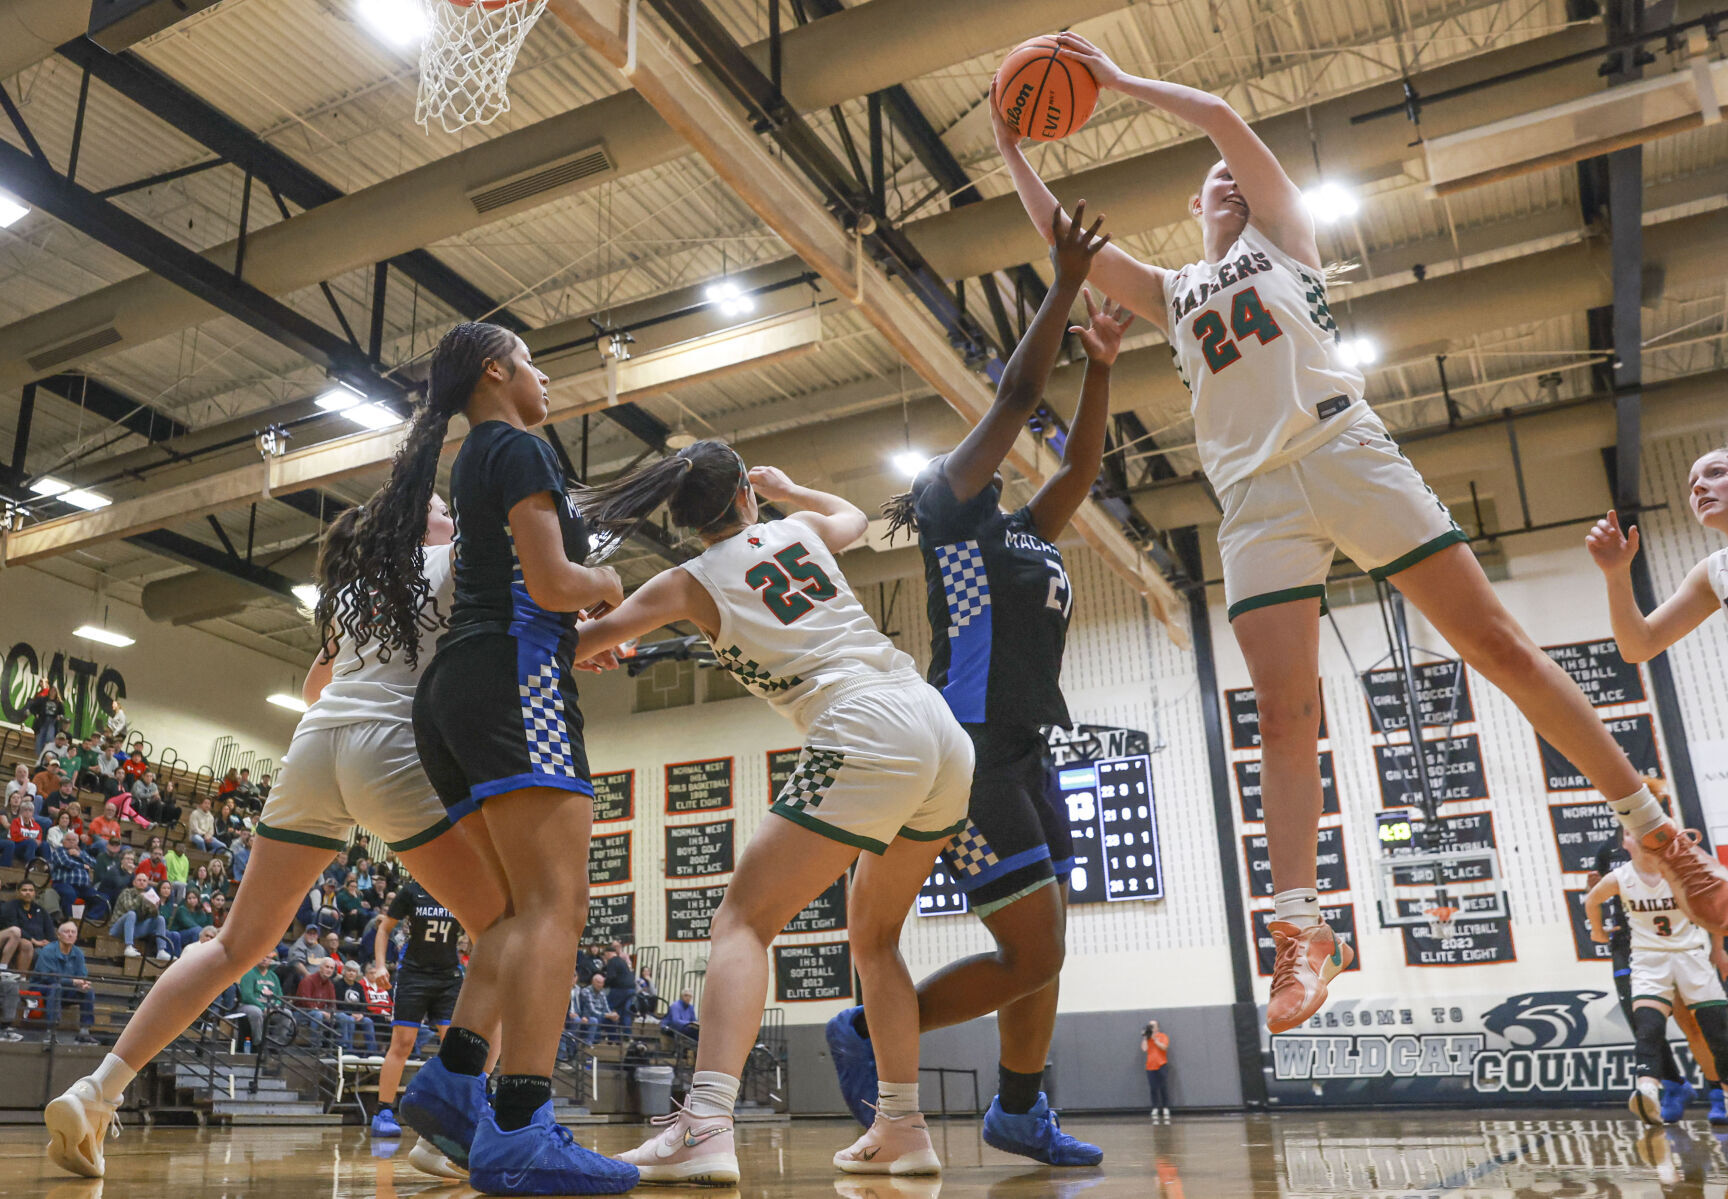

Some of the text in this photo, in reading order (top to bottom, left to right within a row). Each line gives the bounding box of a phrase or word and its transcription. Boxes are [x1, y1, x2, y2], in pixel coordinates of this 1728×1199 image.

[1192, 285, 1283, 375] 24
[745, 541, 838, 626] 25
[1447, 817, 1480, 830] WEST
[1593, 817, 1620, 829] IHS
[671, 823, 727, 837] NORMAL WEST
[689, 836, 710, 845] IHSA
[677, 843, 722, 856] BOYS GOLF
[697, 862, 722, 874] PLACE
[672, 891, 702, 900] NORMAL
[687, 900, 712, 909] IHSA
[812, 918, 836, 928] EIGHT
[1653, 915, 1672, 937] 3
[424, 920, 452, 943] 24
[1441, 938, 1473, 950] 2023
[781, 945, 843, 957] NORMAL WEST
[1421, 948, 1498, 963] ELITE EIGHT
[800, 957, 824, 966] IHSA
[790, 967, 835, 978] SOFTBALL
[787, 987, 840, 999] ELITE EIGHT
[1297, 1007, 1463, 1029] ELCOME TO
[1273, 1036, 1482, 1080] WILDCAT
[1474, 1043, 1705, 1092] COUNTY
